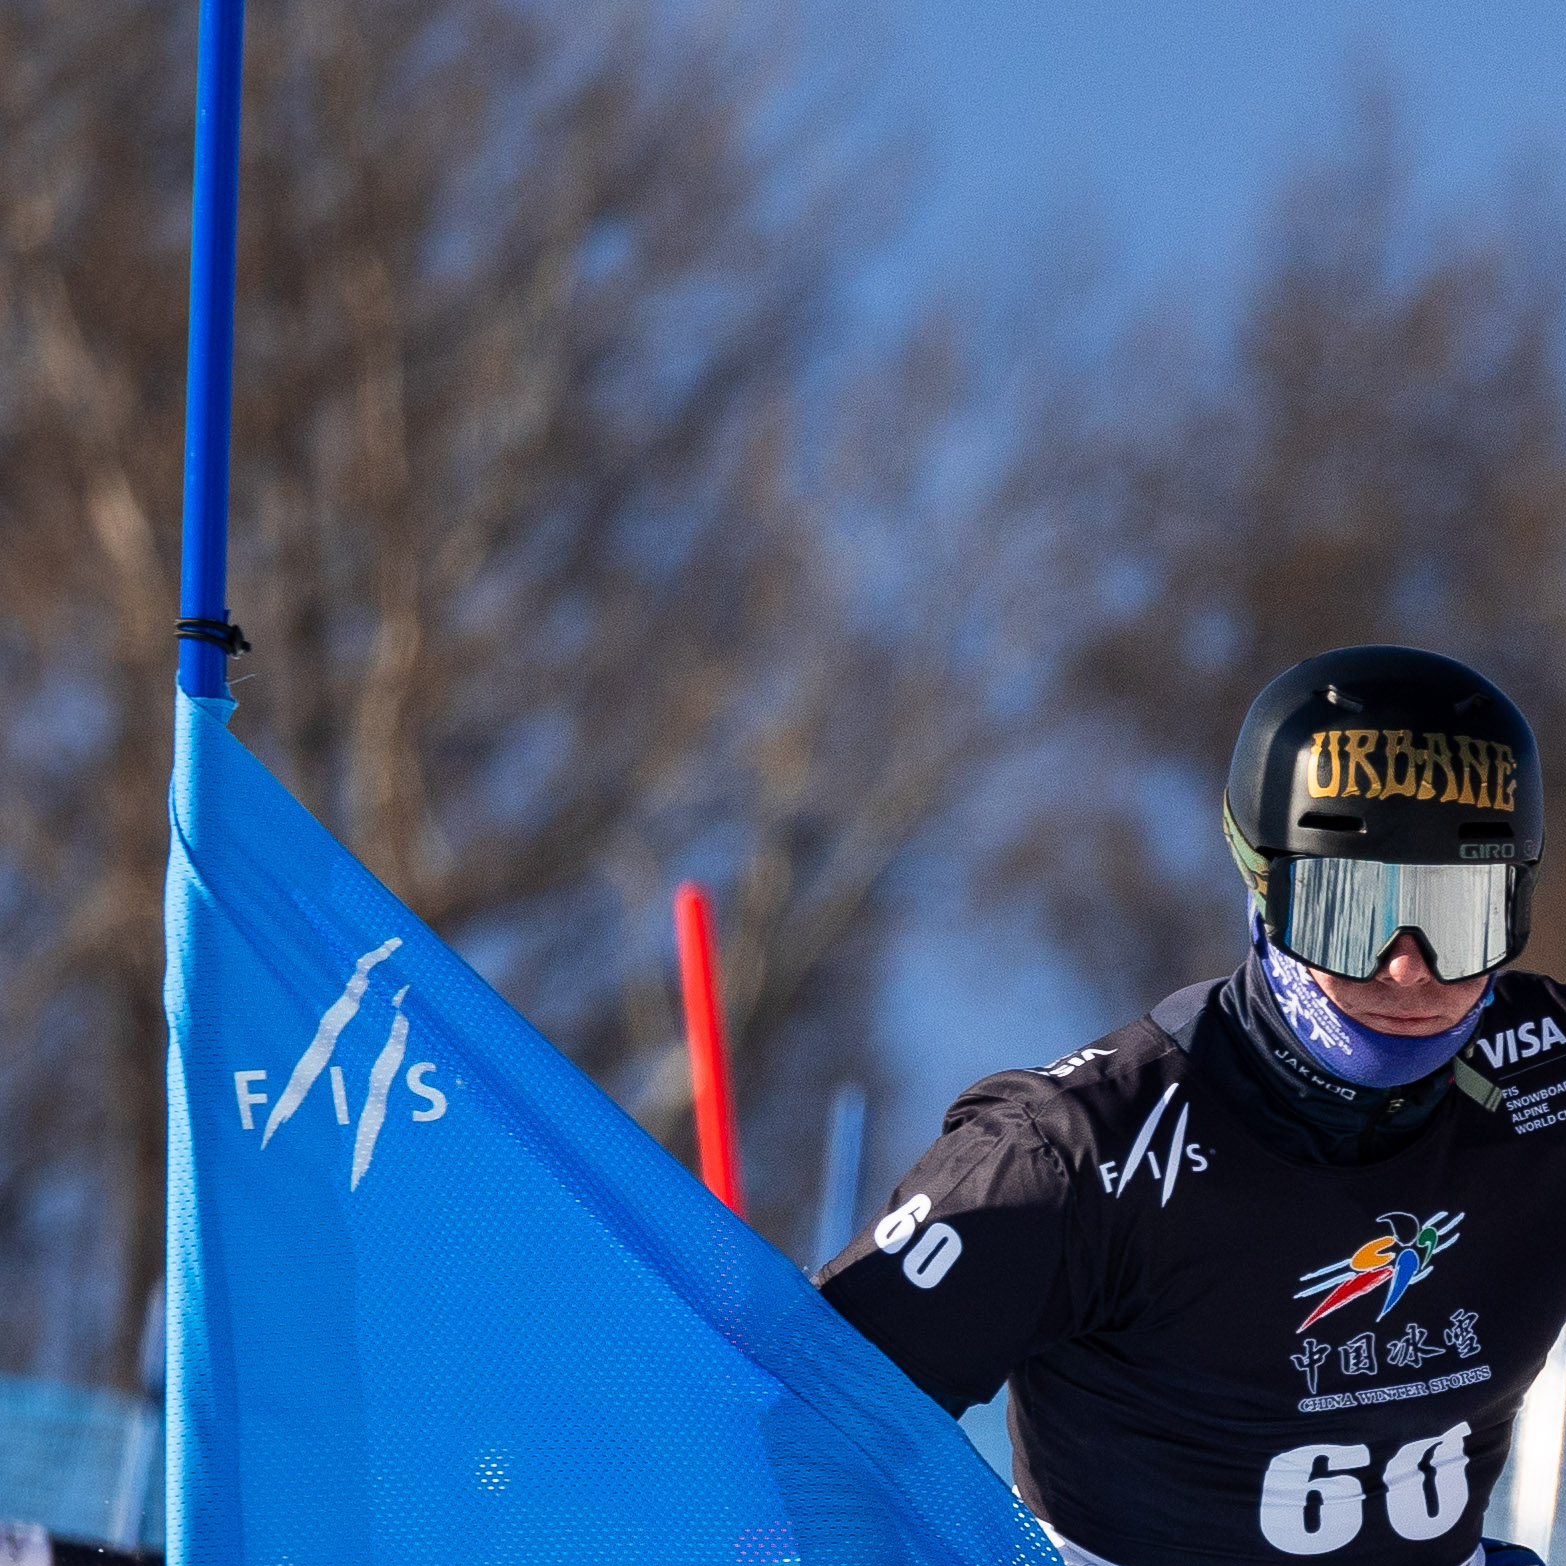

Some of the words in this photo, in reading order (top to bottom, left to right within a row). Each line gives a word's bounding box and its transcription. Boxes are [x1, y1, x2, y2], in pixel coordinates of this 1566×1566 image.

[1307, 729, 1517, 812] URBANE
[1460, 843, 1516, 859] GIRO
[1501, 1085, 1520, 1099] FIS
[1512, 1102, 1551, 1123] ALPINE
[1514, 1114, 1557, 1135] WORLD
[874, 1193, 963, 1289] 60
[1298, 1393, 1358, 1413] CHINA
[1356, 1382, 1429, 1405] WINTER
[1428, 1365, 1492, 1394] SPORTS
[1260, 1420, 1472, 1555] 60
